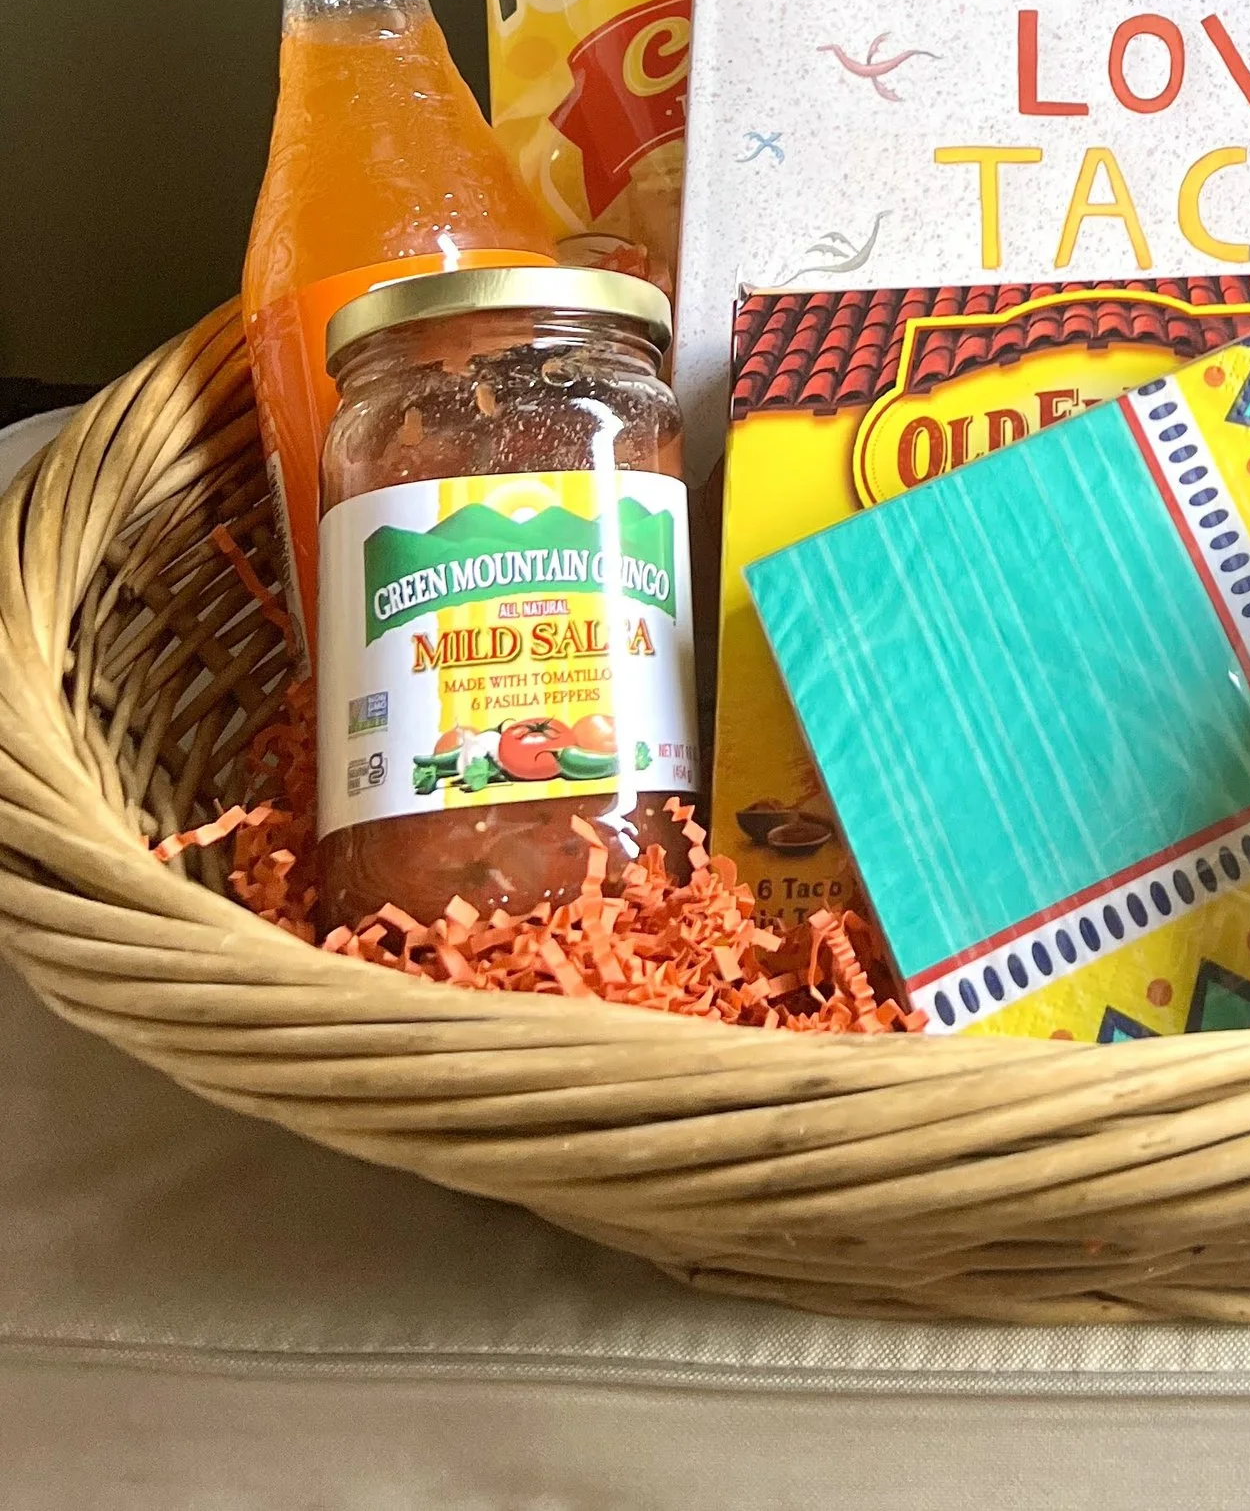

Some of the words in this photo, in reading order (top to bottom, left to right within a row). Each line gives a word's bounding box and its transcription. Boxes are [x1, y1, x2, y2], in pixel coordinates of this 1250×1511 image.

[374, 563, 449, 621] GREEN
[453, 548, 589, 592] MOUNTAIN
[499, 603, 519, 618] ALL
[523, 600, 570, 617] NATURAL
[412, 626, 521, 673] MILD
[530, 617, 655, 660] SALA
[444, 677, 485, 693] MADE
[489, 674, 527, 689] WITH
[531, 670, 612, 686] TOMATILLO
[484, 694, 540, 710] PASILLA
[544, 688, 601, 704] PEPPERS
[757, 878, 773, 900] 6
